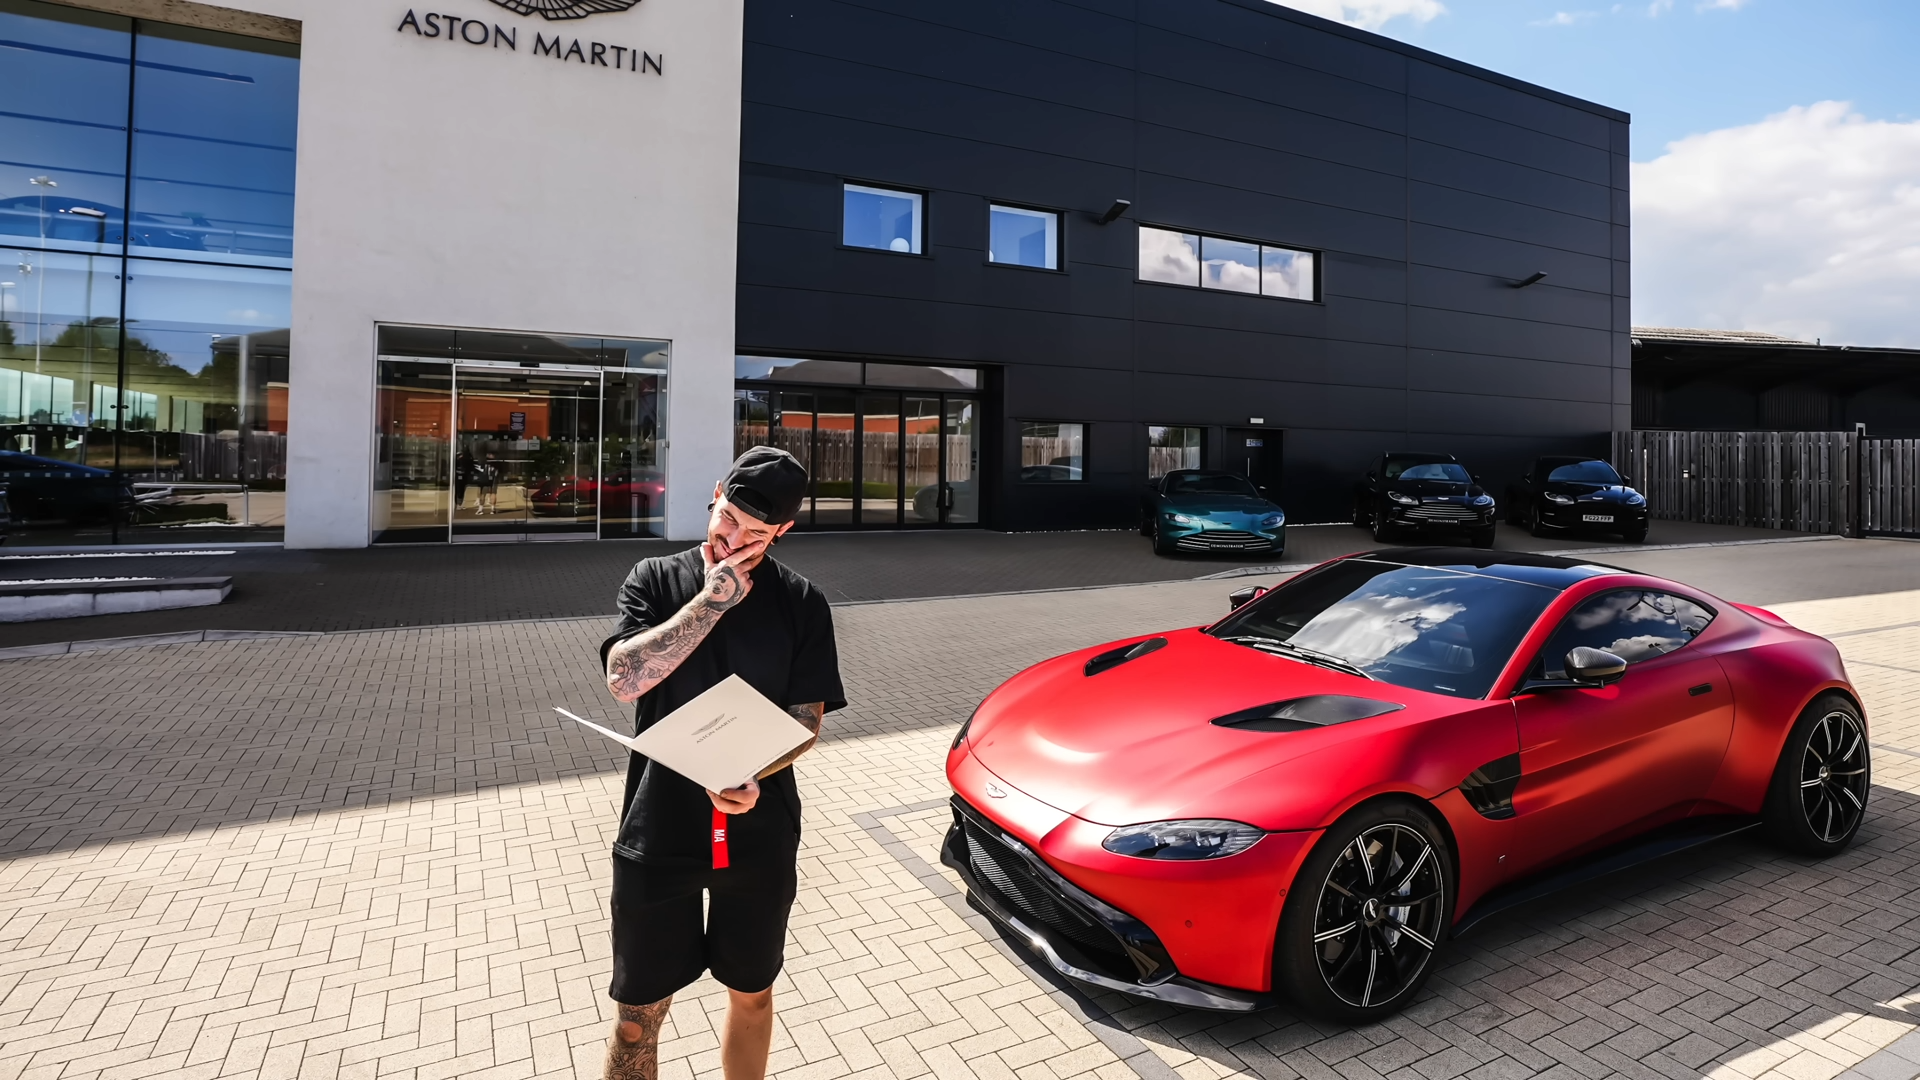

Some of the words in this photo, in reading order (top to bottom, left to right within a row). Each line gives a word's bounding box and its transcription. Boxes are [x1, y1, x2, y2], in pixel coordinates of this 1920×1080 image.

[397, 8, 517, 51] ASTON
[533, 31, 663, 77] MARTIN
[696, 730, 715, 744] ASTON
